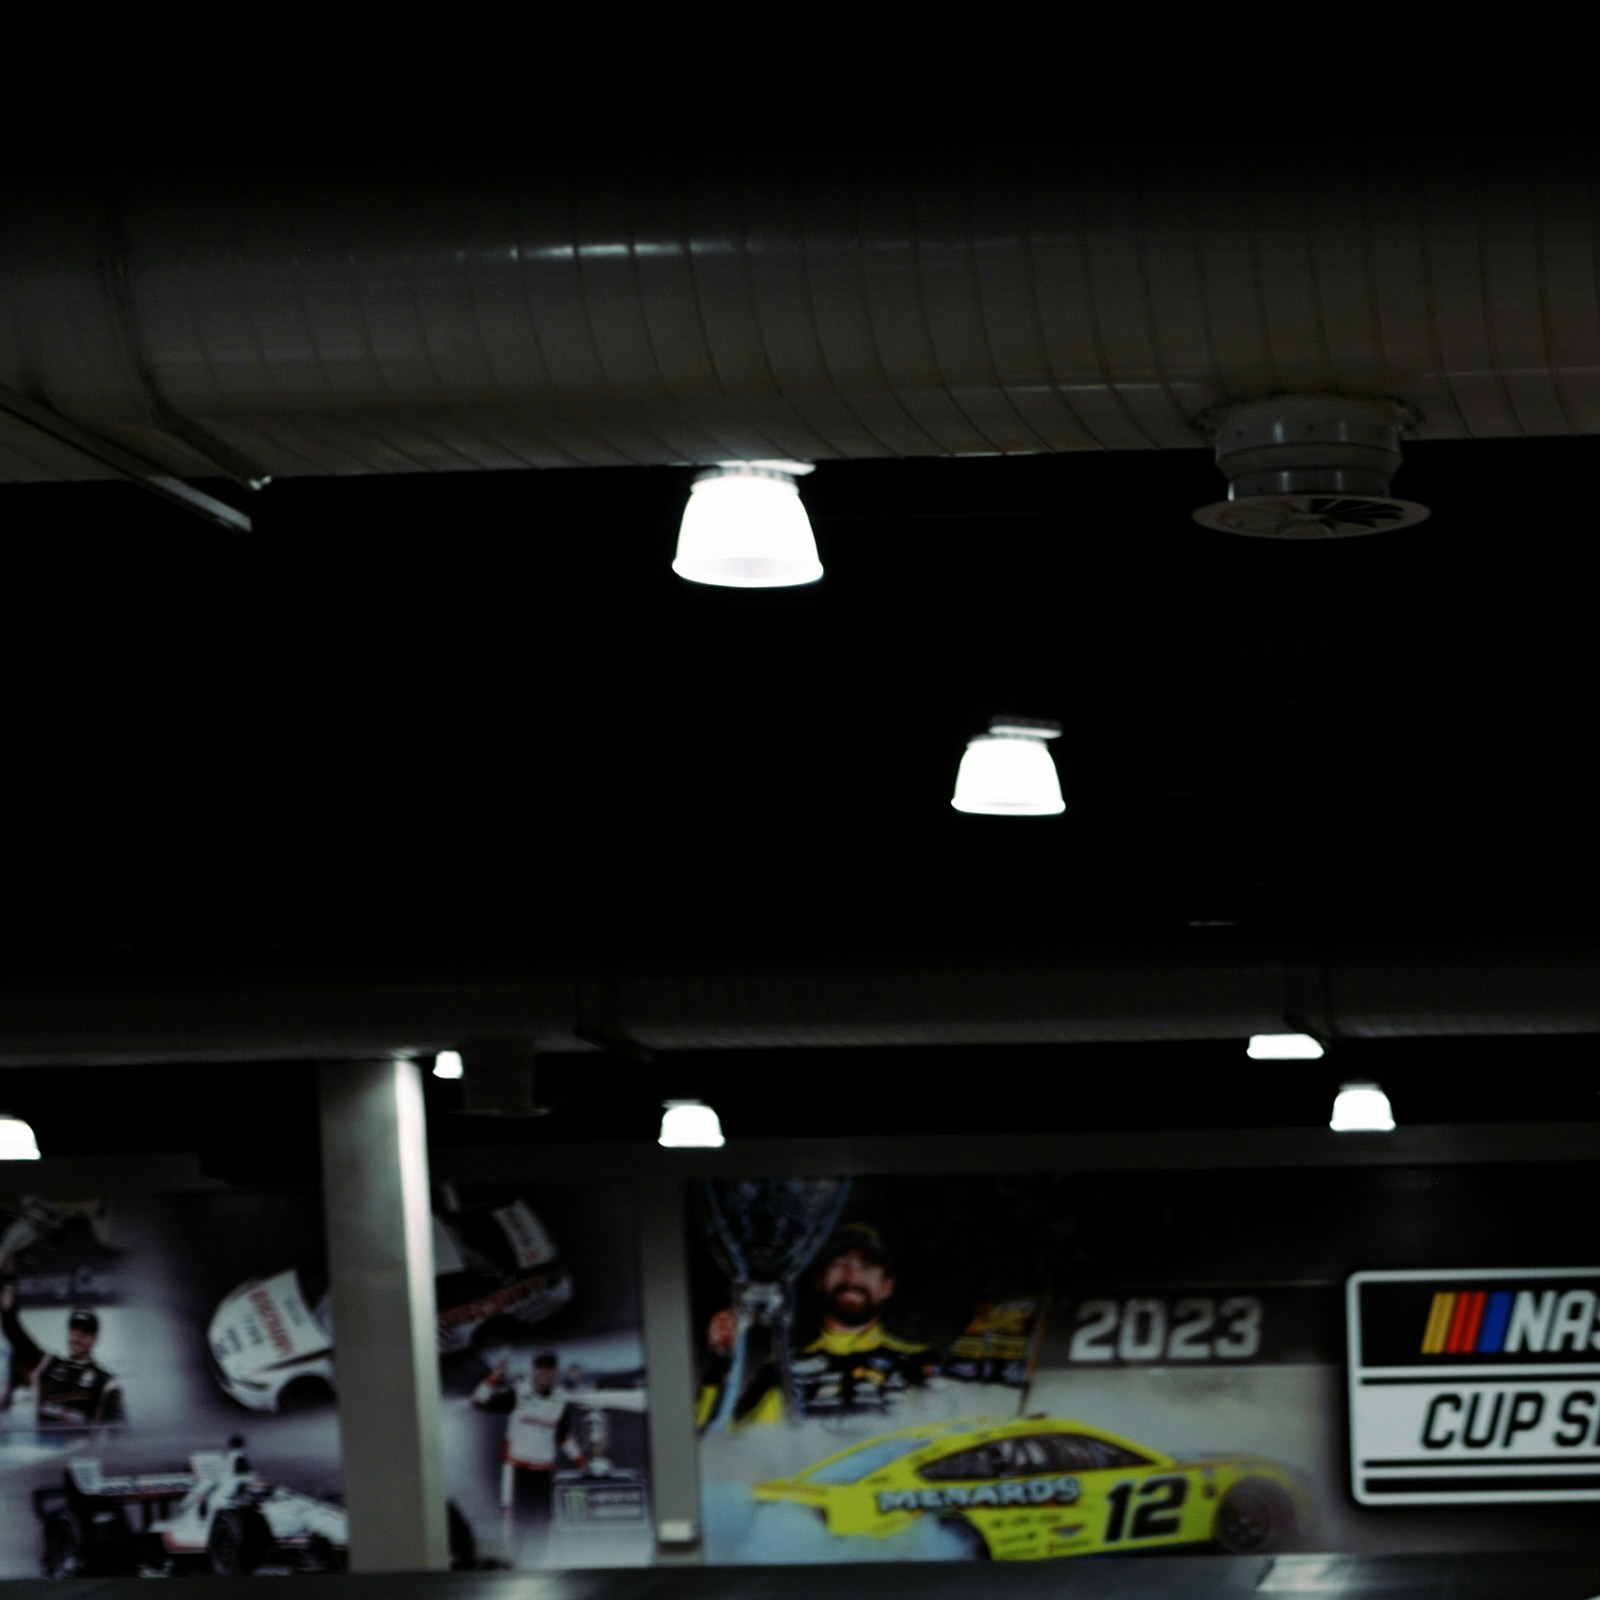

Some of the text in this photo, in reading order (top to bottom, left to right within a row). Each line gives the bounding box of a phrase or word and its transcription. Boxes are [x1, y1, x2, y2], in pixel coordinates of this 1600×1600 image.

[1068, 1295, 1264, 1363] 2023
[1422, 1392, 1545, 1449] CUP
[876, 1475, 1081, 1514] MENARDS
[1103, 1473, 1188, 1545] 12
